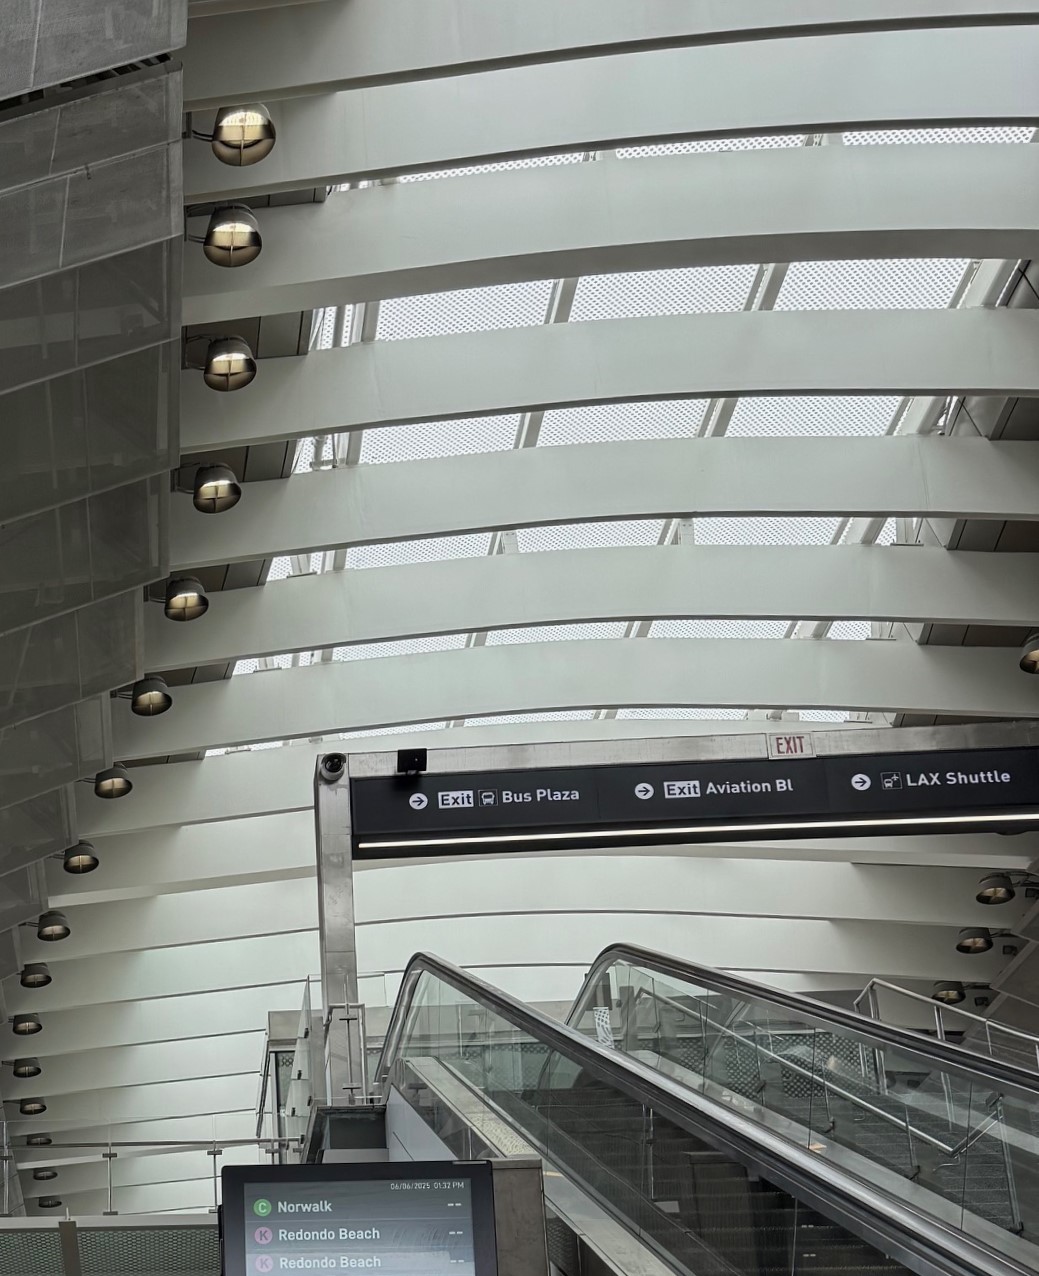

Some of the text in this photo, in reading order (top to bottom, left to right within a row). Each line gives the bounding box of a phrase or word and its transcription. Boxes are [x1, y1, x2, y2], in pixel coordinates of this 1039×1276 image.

[775, 736, 805, 754] EXIT
[906, 770, 1011, 787] LAX Shuttle
[666, 779, 794, 797] Exit Aviation Bl
[441, 788, 580, 806] Exit Bus Plaza
[452, 1181, 465, 1189] PM
[258, 1200, 332, 1213] C Norwalk
[260, 1227, 381, 1241] K Redondo Beach
[260, 1255, 382, 1269] K Redondo Beach
